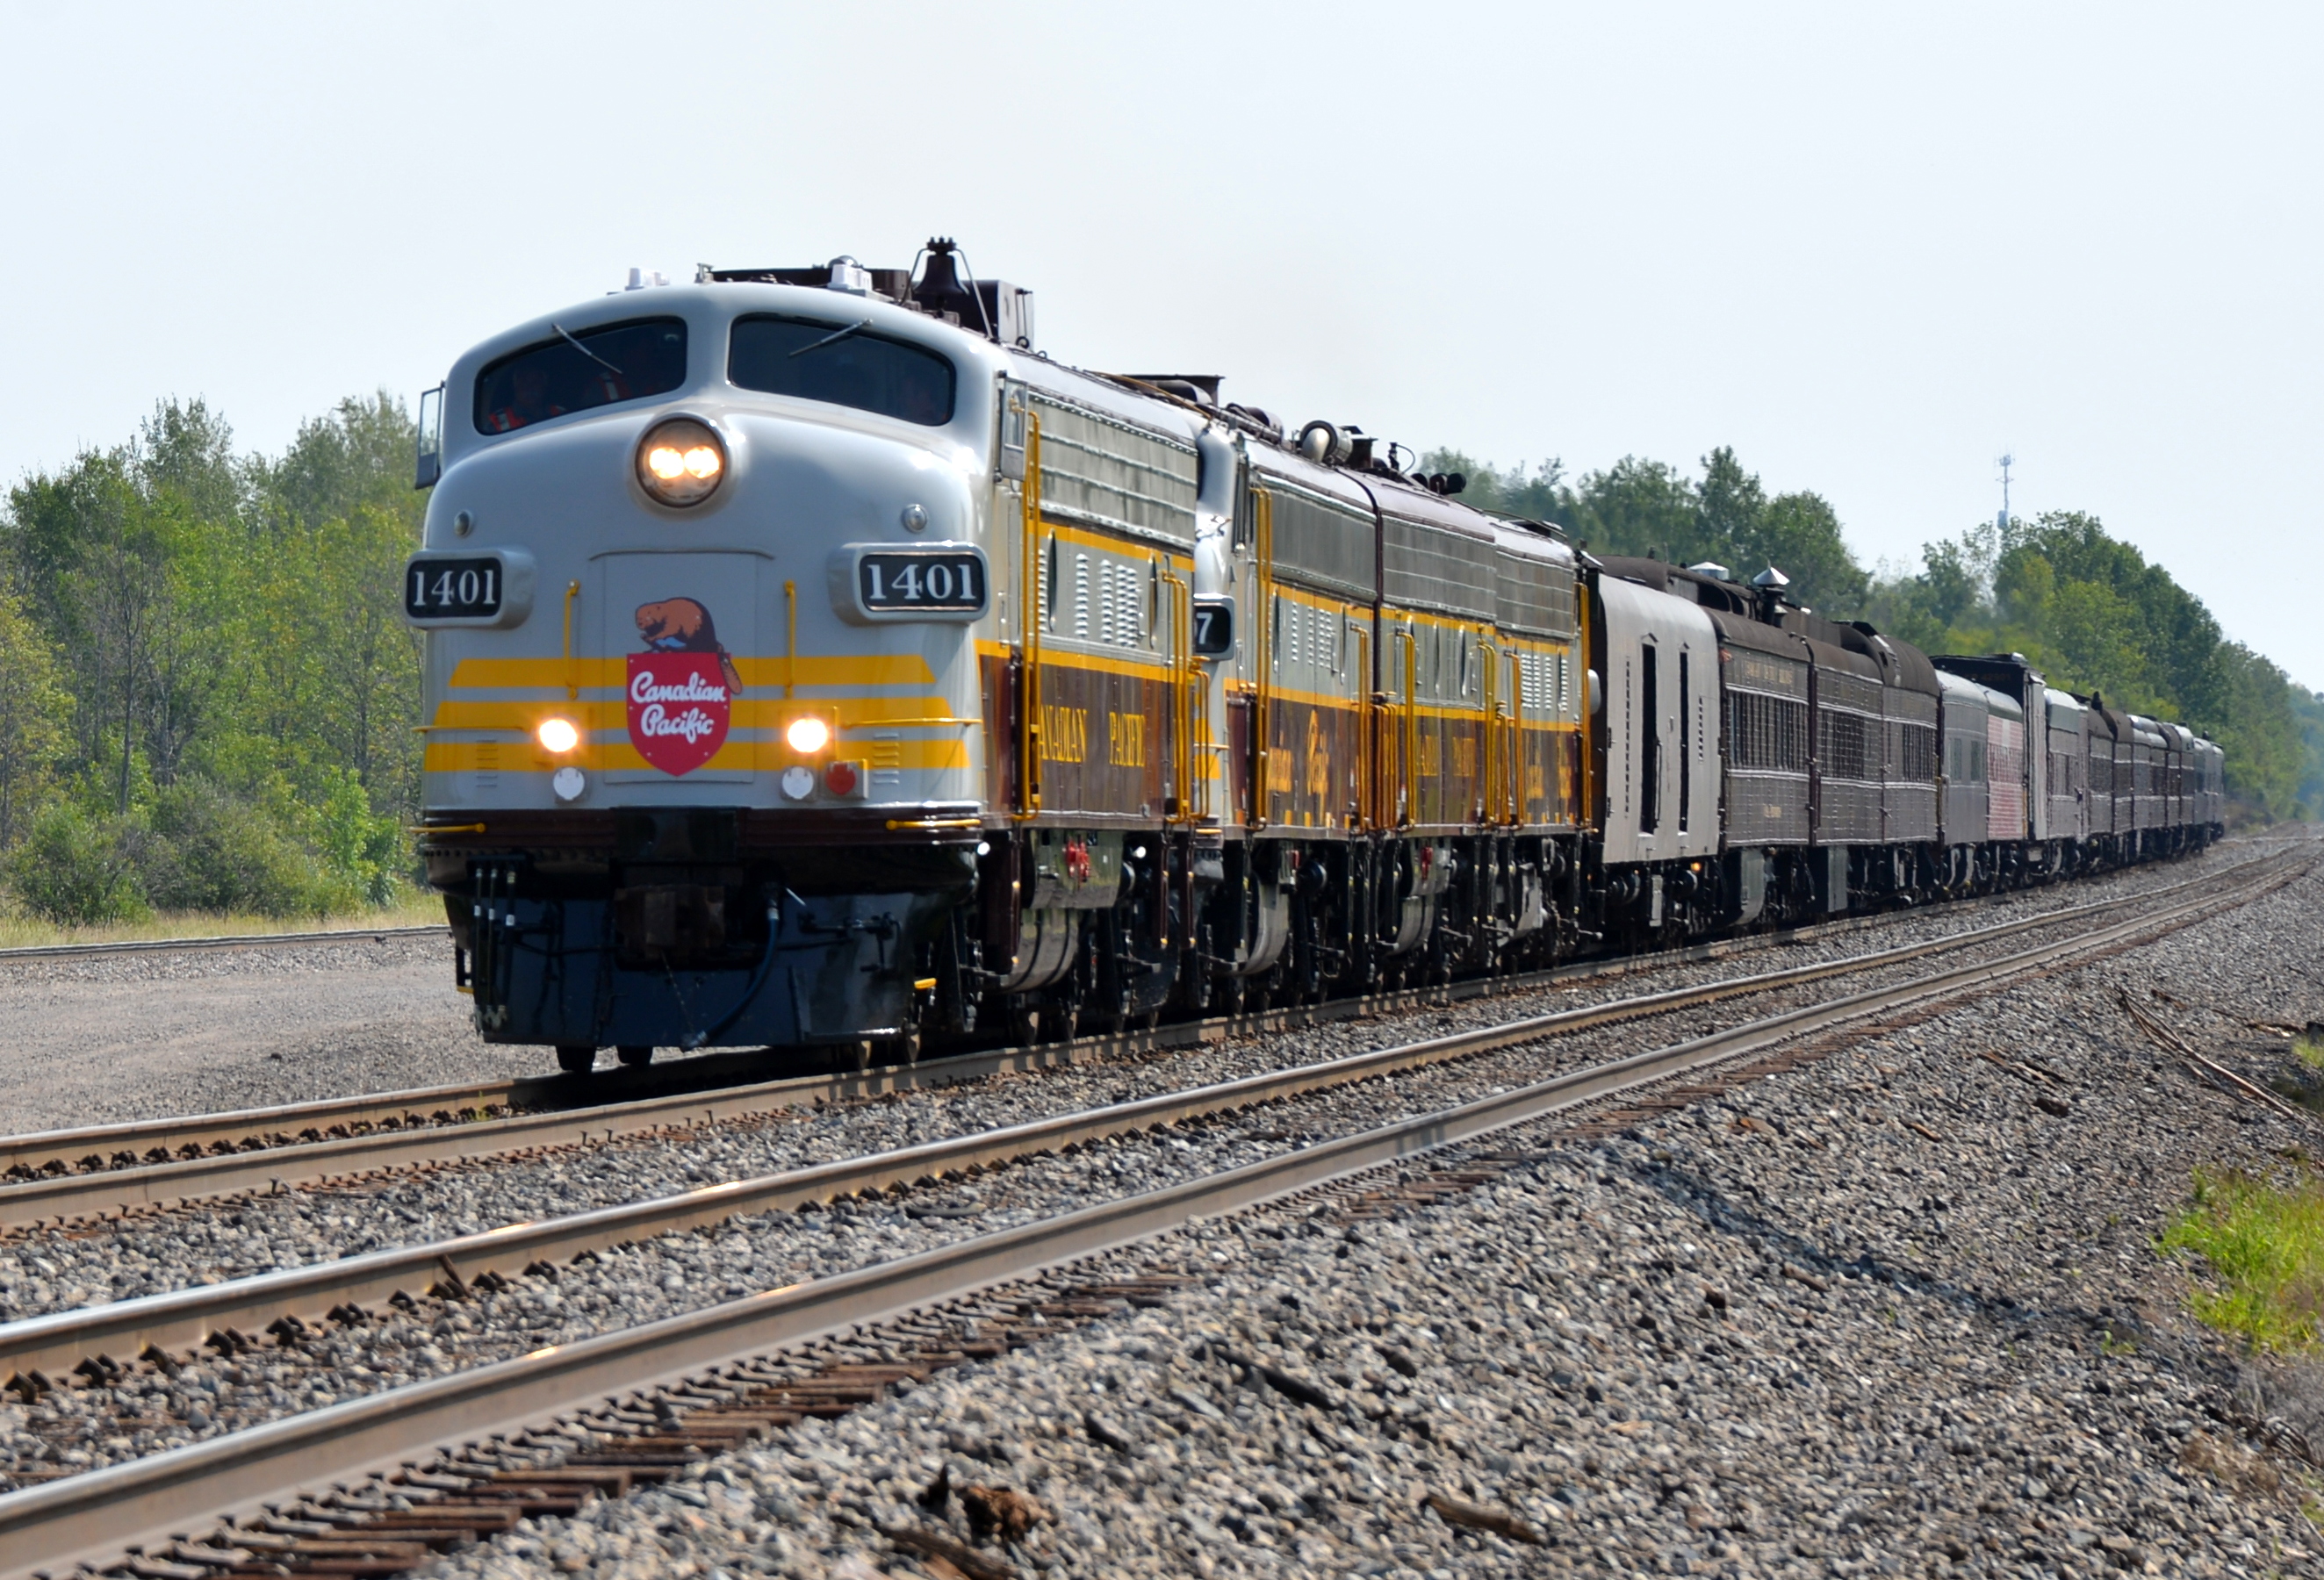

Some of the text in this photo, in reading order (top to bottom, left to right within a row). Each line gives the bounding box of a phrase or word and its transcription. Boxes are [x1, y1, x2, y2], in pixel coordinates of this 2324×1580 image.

[414, 570, 496, 606] 1401
[867, 564, 977, 600] 1401
[1194, 612, 1213, 645] 7
[630, 671, 726, 703] Canadian
[640, 703, 715, 743] Pacific
[1039, 705, 1088, 762] ANADIAN
